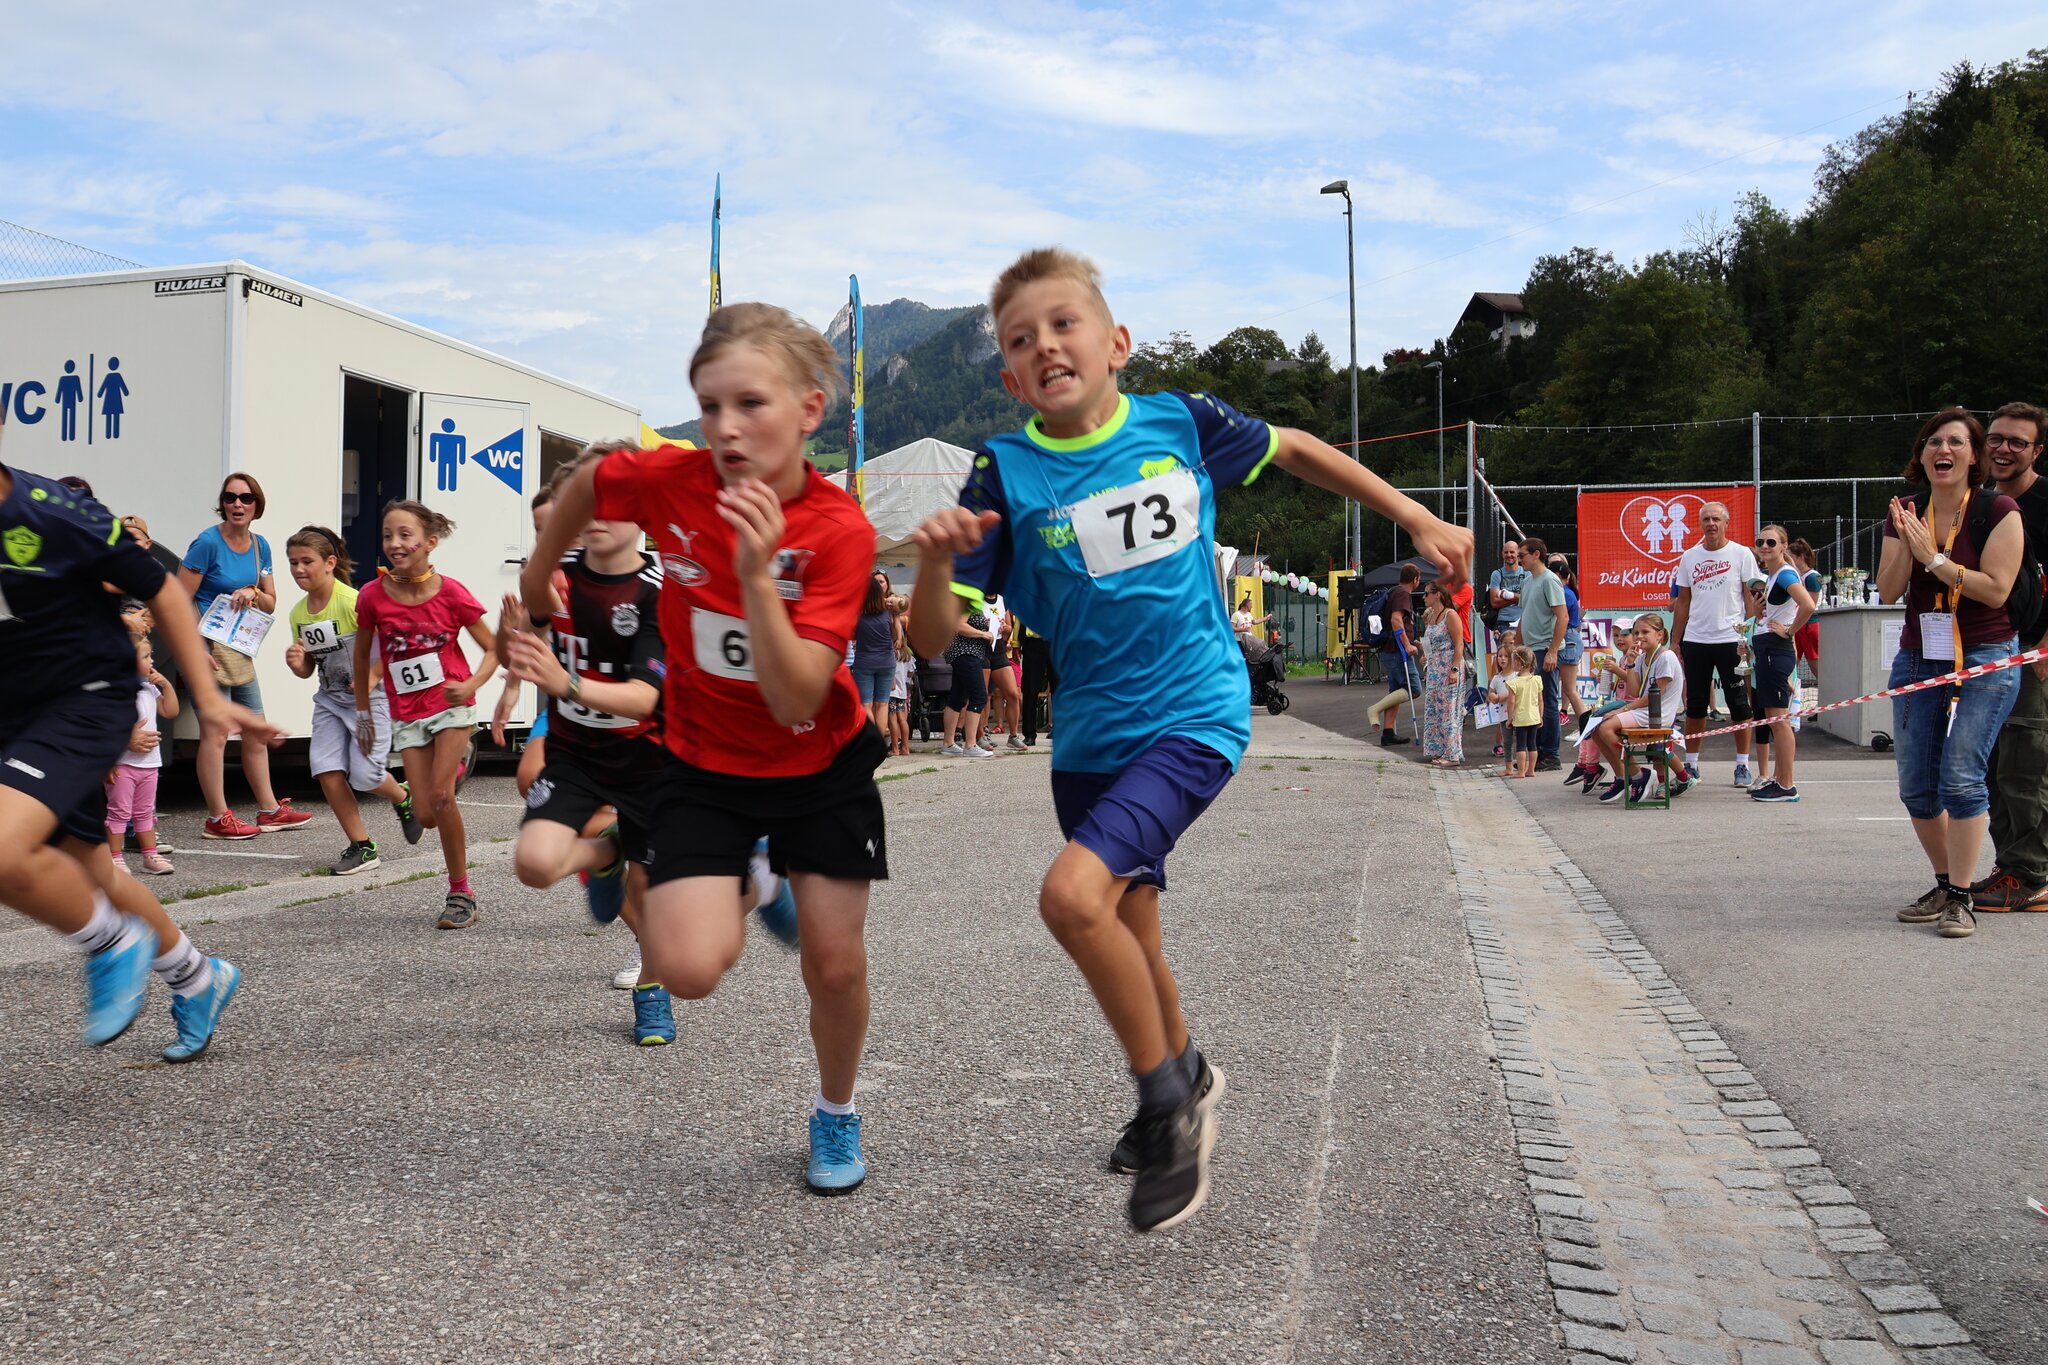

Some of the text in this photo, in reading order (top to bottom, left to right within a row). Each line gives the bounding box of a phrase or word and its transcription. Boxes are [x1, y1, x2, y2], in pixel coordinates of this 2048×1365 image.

[157, 277, 225, 292] HUMER
[250, 279, 301, 306] HUMER
[487, 448, 521, 470] WC
[1105, 493, 1177, 551] 73
[1598, 570, 1621, 585] Die
[1692, 560, 1731, 579] Superior
[1642, 591, 1671, 600] Losen
[304, 627, 326, 646] 80
[401, 663, 429, 686] 61
